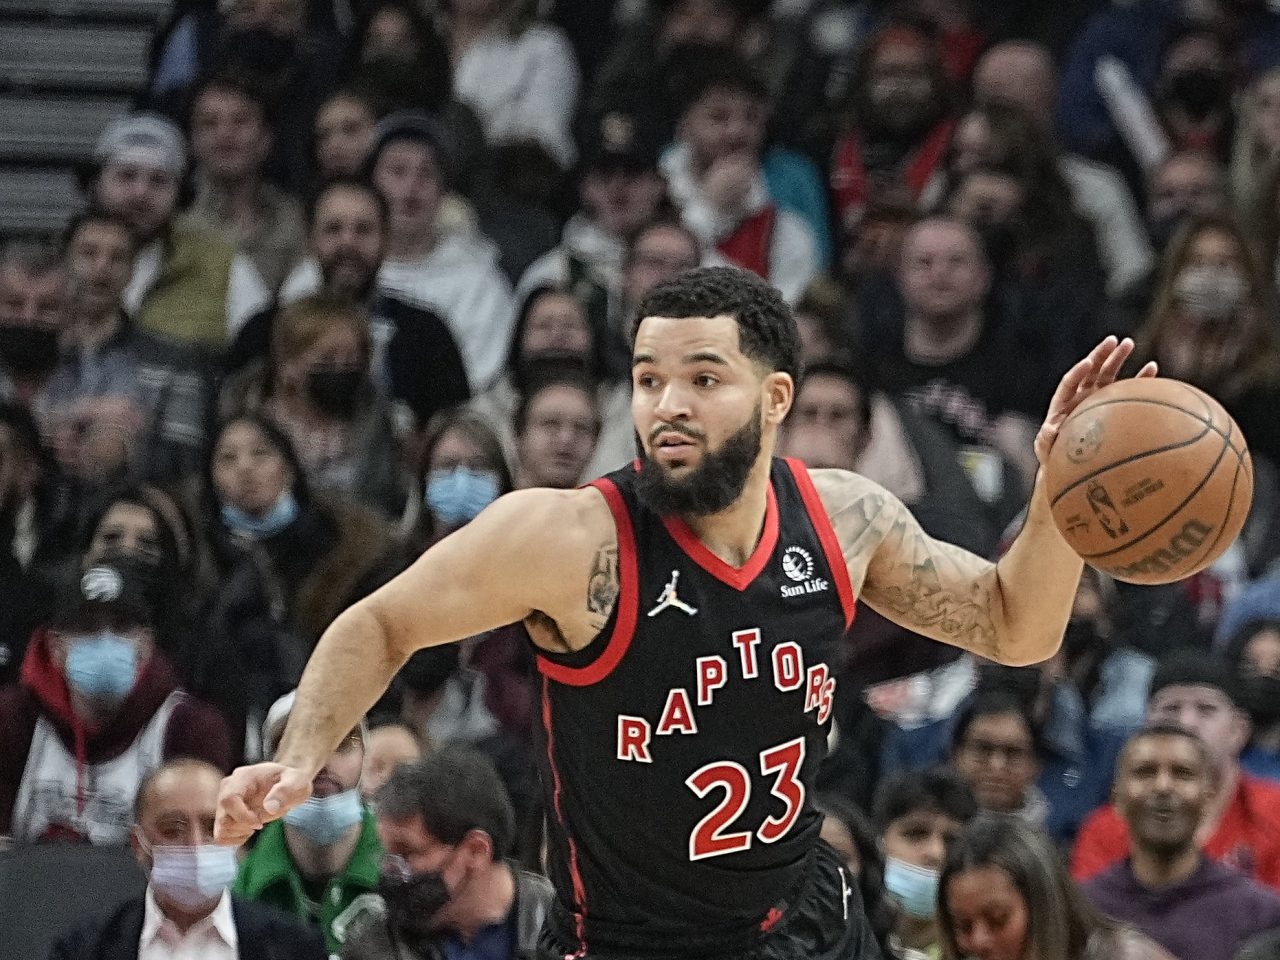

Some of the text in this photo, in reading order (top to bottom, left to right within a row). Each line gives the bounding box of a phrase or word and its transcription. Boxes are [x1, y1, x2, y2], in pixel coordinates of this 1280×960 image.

[780, 577, 829, 598] Sun Life
[617, 627, 836, 763] RAPTORS
[685, 736, 806, 861] 23
